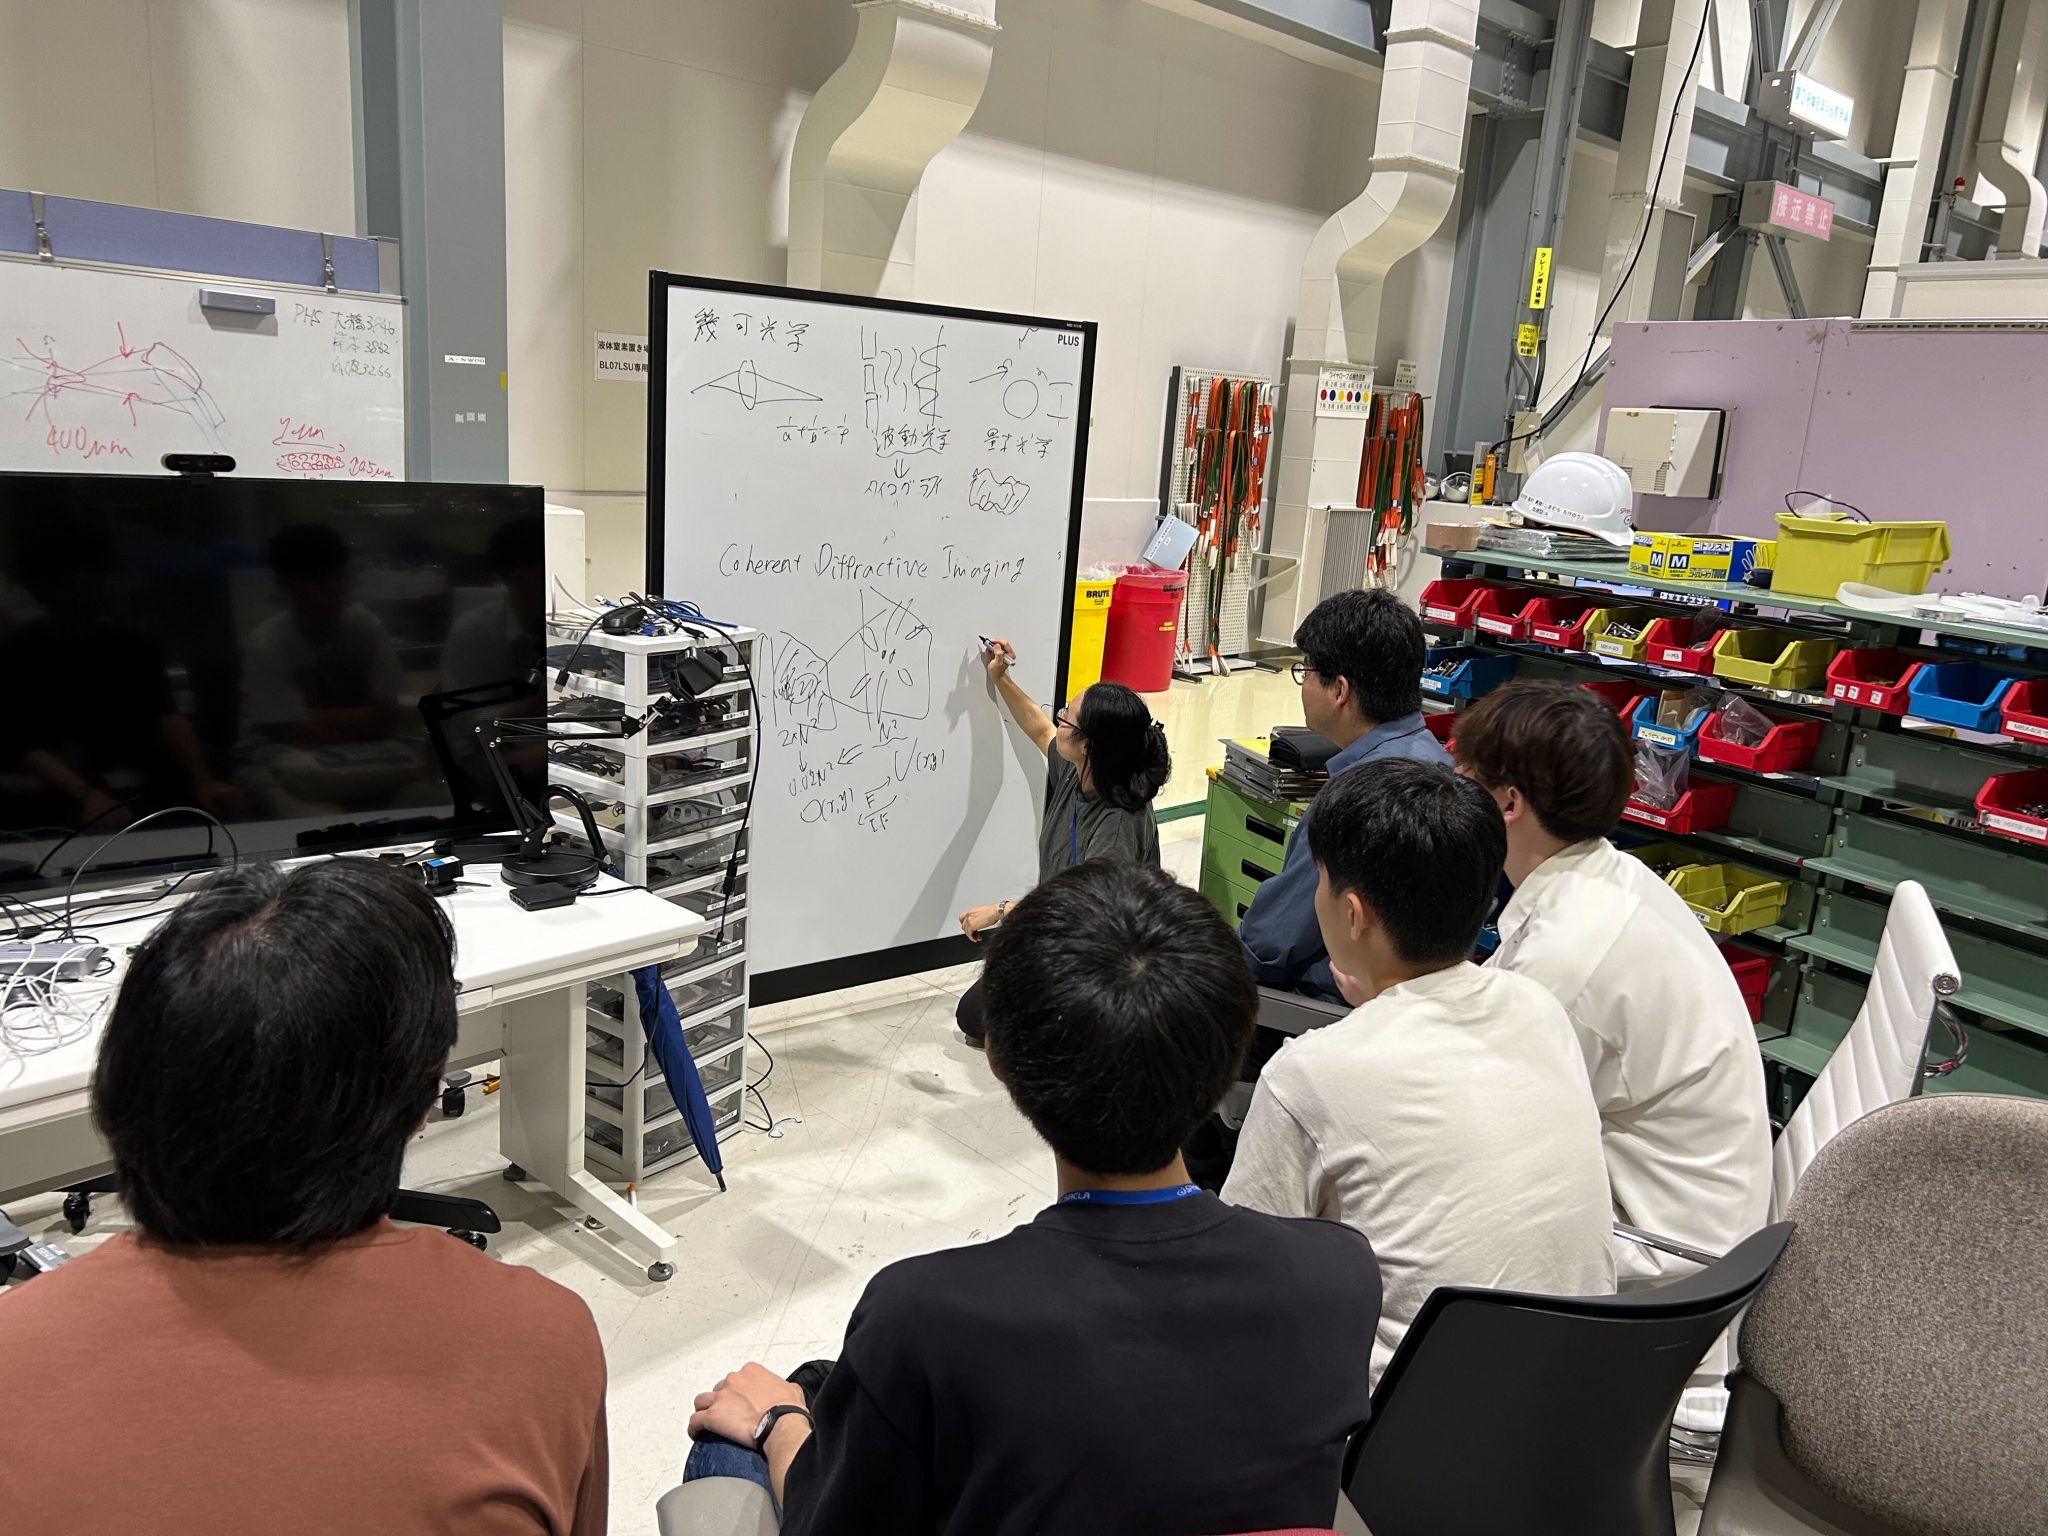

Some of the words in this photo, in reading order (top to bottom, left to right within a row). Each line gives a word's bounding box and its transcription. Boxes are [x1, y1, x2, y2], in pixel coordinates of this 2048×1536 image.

[1776, 191, 1829, 231] 接近禁止
[294, 303, 322, 326] PHS
[1057, 333, 1080, 347] PLUS
[1694, 541, 1731, 551] ニトリスト
[719, 543, 802, 577] Coherent
[814, 543, 929, 580] Diffractive
[942, 545, 1026, 585] Imaging
[1651, 554, 1663, 566] M
[1671, 557, 1687, 568] M
[1086, 590, 1110, 598] BRUTE
